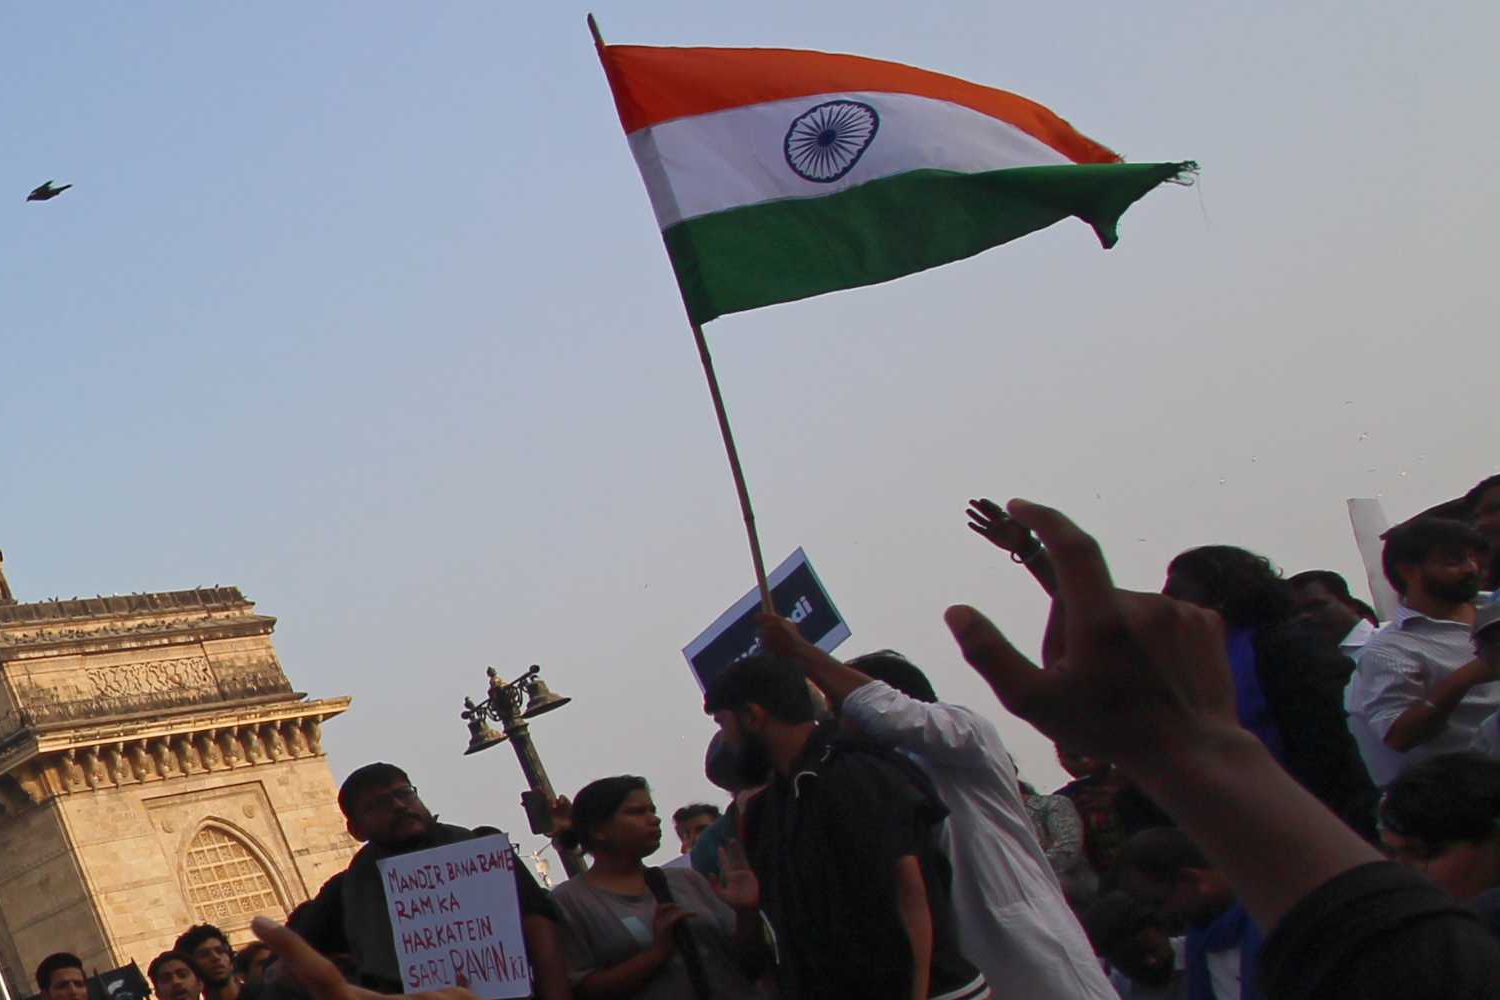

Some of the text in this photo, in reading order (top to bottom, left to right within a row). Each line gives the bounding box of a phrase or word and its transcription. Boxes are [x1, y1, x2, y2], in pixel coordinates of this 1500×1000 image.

[387, 864, 445, 893] MANDIR
[395, 892, 460, 920] RAM KA
[402, 915, 493, 954] HARKATEIN
[449, 941, 510, 988] RAVAN
